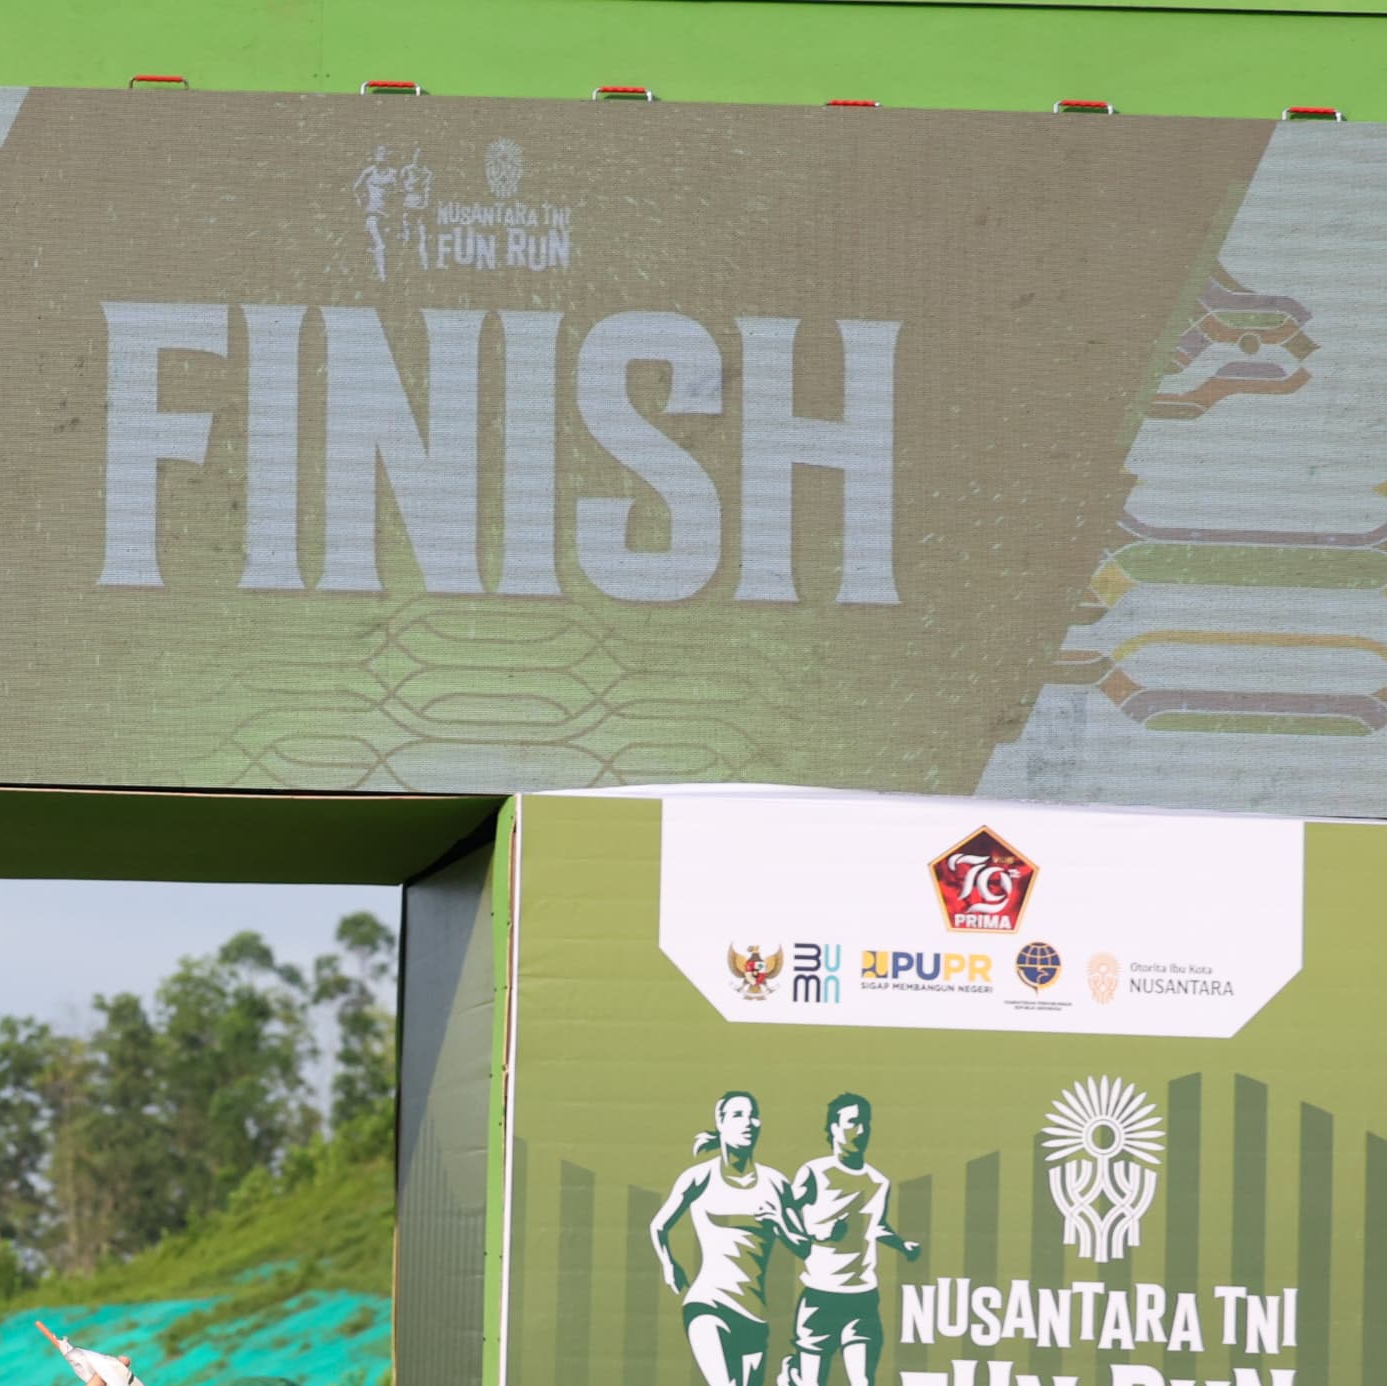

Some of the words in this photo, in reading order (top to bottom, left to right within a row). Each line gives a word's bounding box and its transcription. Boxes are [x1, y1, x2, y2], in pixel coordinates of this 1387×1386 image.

[437, 200, 539, 226] NUSANTARA
[436, 226, 497, 271] FUN
[506, 227, 572, 272] RUN
[96, 301, 903, 604] FINISH
[947, 853, 1013, 914] 79
[953, 913, 1012, 930] PRIMA
[891, 951, 994, 983] PUPR
[1129, 962, 1167, 974] Otorita
[1169, 963, 1187, 974] Ibu
[1189, 964, 1213, 975] Kota
[860, 981, 890, 991] SIGAP
[892, 983, 955, 993] MEMBANGUN
[957, 985, 993, 994] NEGERI
[1129, 978, 1235, 997] NUSANTARA
[899, 1277, 1205, 1352] NUSANTARA
[1214, 1286, 1298, 1355] TNI
